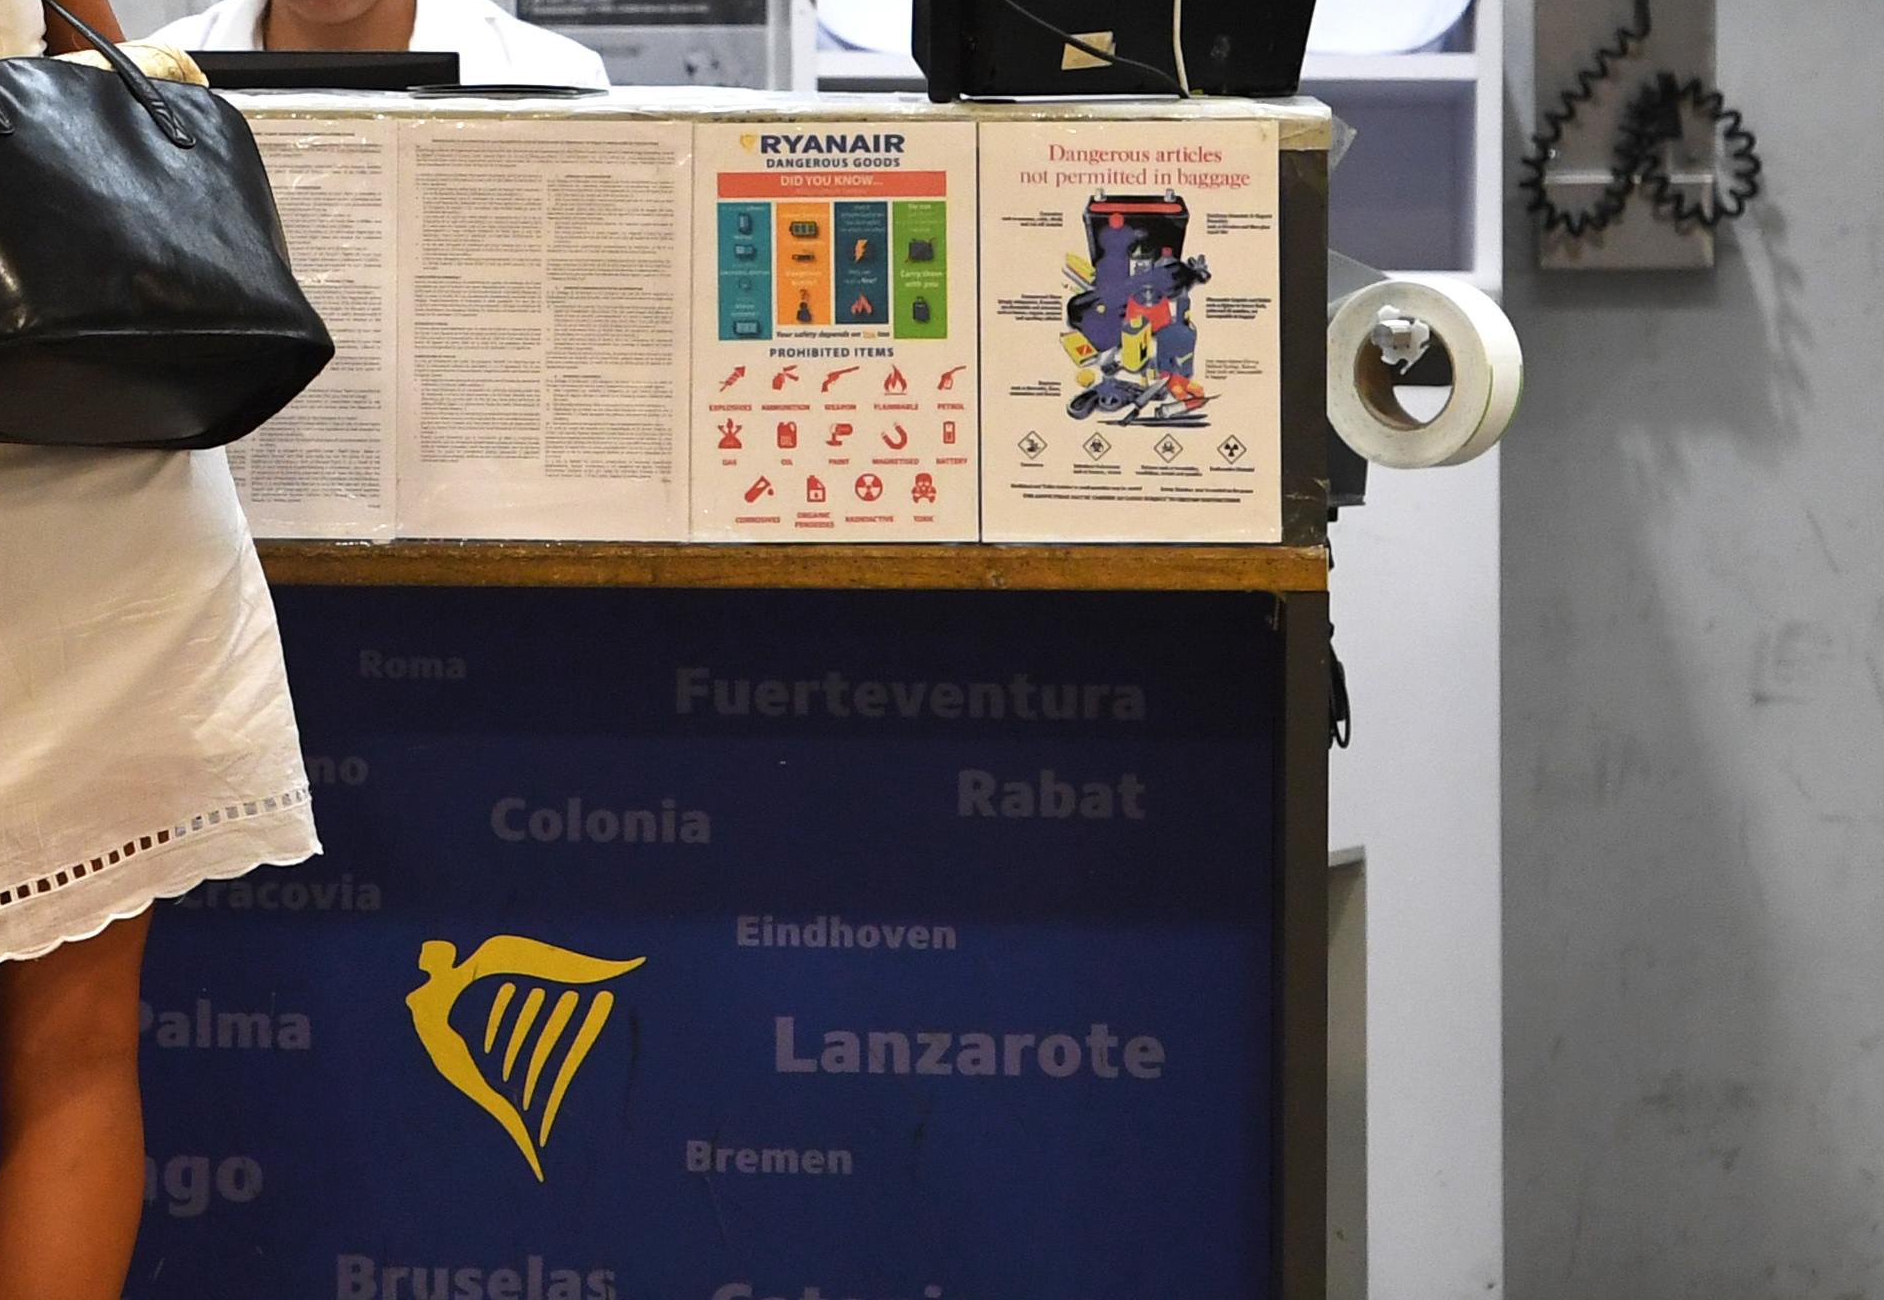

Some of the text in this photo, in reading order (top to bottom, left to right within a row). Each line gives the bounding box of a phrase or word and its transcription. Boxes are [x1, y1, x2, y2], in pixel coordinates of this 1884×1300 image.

[760, 134, 905, 155] RYANAIR
[1048, 144, 1223, 166] Dangerous articles
[766, 157, 901, 169] DANGEROUS GOODS
[780, 175, 804, 187] DID
[806, 175, 832, 187] YOU
[1019, 168, 1251, 189] not permitted in baggage
[769, 347, 895, 358] PROHIBITED ITEMS
[722, 458, 738, 466] GAS
[780, 458, 794, 466] OIL
[936, 457, 968, 465] BATTERY
[359, 649, 467, 680] Roma
[675, 666, 1145, 720] Fuerteventura
[957, 768, 1145, 819] Rabat
[490, 796, 711, 844] Colonia
[736, 916, 957, 950] Eindhoven
[774, 1015, 1164, 1079] Lanzarote
[685, 1139, 852, 1175] Bremen
[336, 1254, 617, 1300] Bruselas
